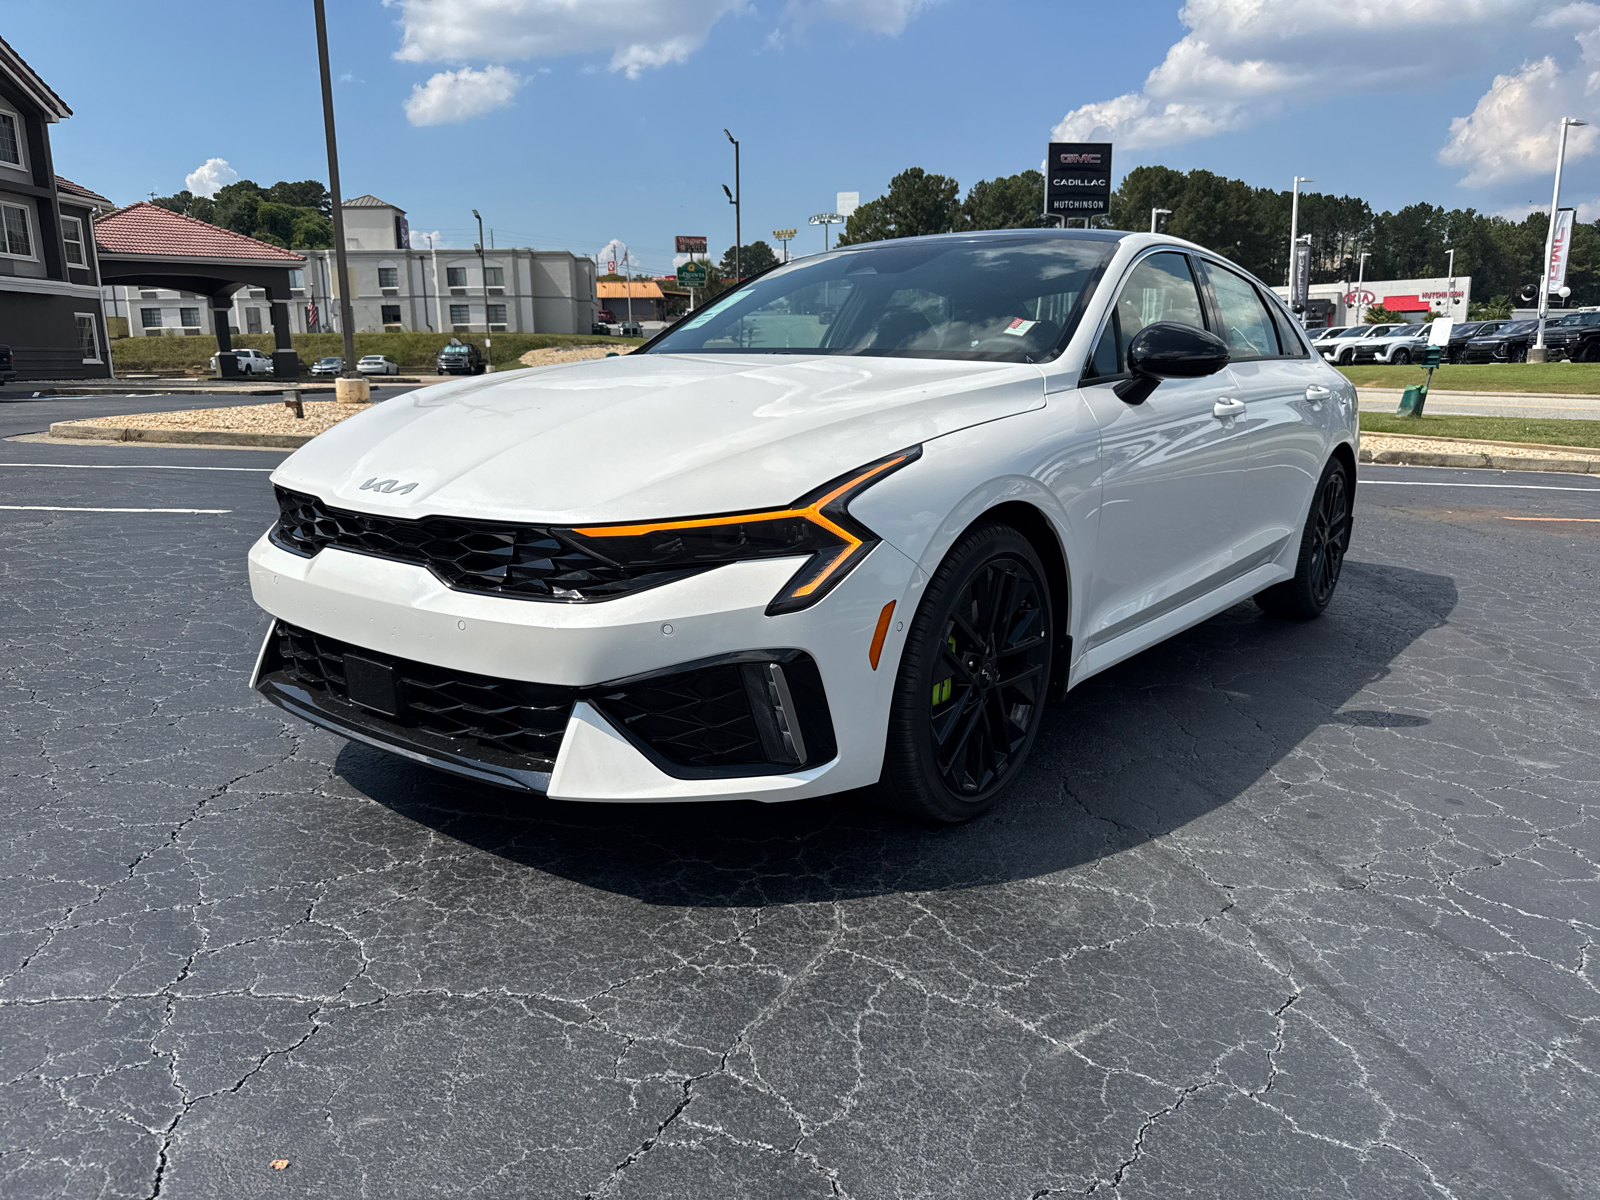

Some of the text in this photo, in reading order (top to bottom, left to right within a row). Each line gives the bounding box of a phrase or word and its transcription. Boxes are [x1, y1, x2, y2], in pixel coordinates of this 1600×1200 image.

[1060, 153, 1101, 163] GMC
[1053, 200, 1104, 209] HUTCHINSON
[359, 477, 419, 495] KIA
